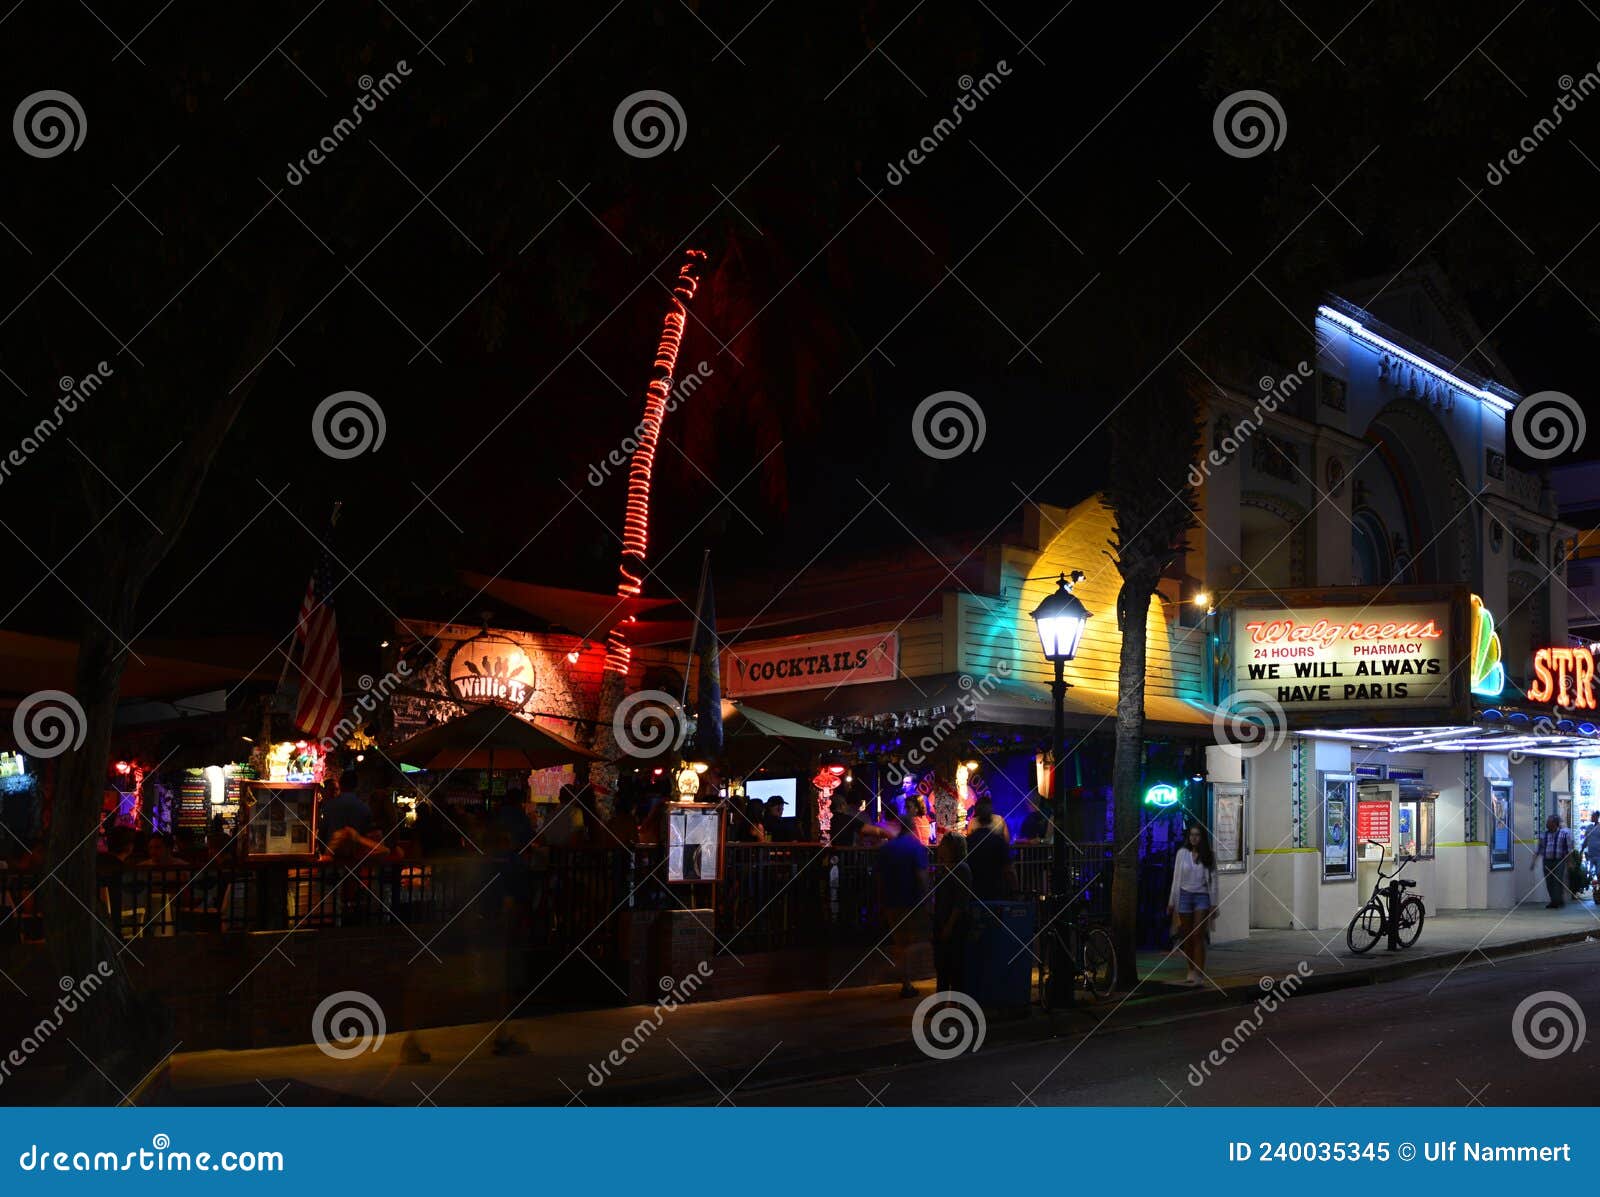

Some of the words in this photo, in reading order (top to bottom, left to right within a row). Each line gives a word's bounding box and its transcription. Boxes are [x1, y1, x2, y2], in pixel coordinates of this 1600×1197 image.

[1245, 618, 1443, 648] Walgreens
[1254, 649, 1268, 659] 24
[1271, 647, 1315, 658] HOURS
[1353, 643, 1422, 655] PHARMACY
[750, 649, 868, 683] COCKTAILS
[1248, 663, 1280, 680] WE
[1295, 661, 1343, 678] WILL
[1355, 659, 1441, 676] ALWAYS
[454, 675, 507, 699] Willie
[1527, 647, 1598, 710] STR
[1277, 684, 1330, 702] HAVE
[1343, 682, 1409, 699] PARIS
[1144, 786, 1178, 804] ATM
